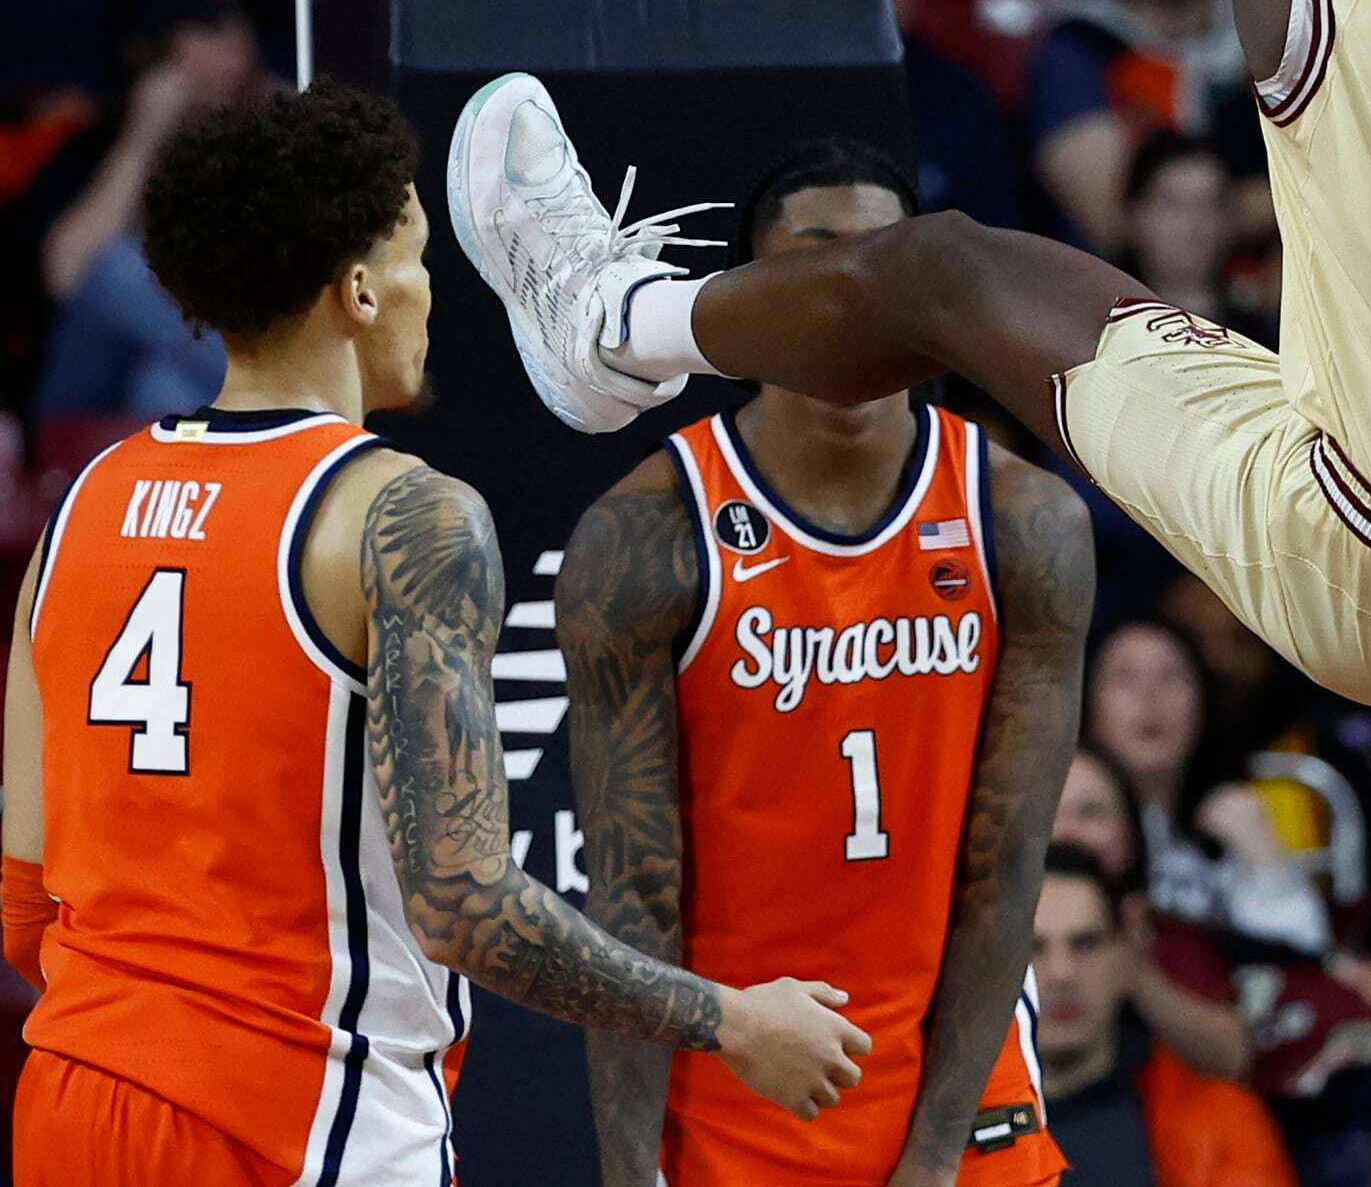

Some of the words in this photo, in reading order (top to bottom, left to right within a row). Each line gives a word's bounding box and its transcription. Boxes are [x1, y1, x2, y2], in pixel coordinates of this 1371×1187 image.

[120, 479, 222, 540] KINGZ
[734, 523, 757, 547] 21
[87, 566, 192, 776] 4
[730, 605, 982, 712] Syracuse
[840, 729, 889, 861] 1
